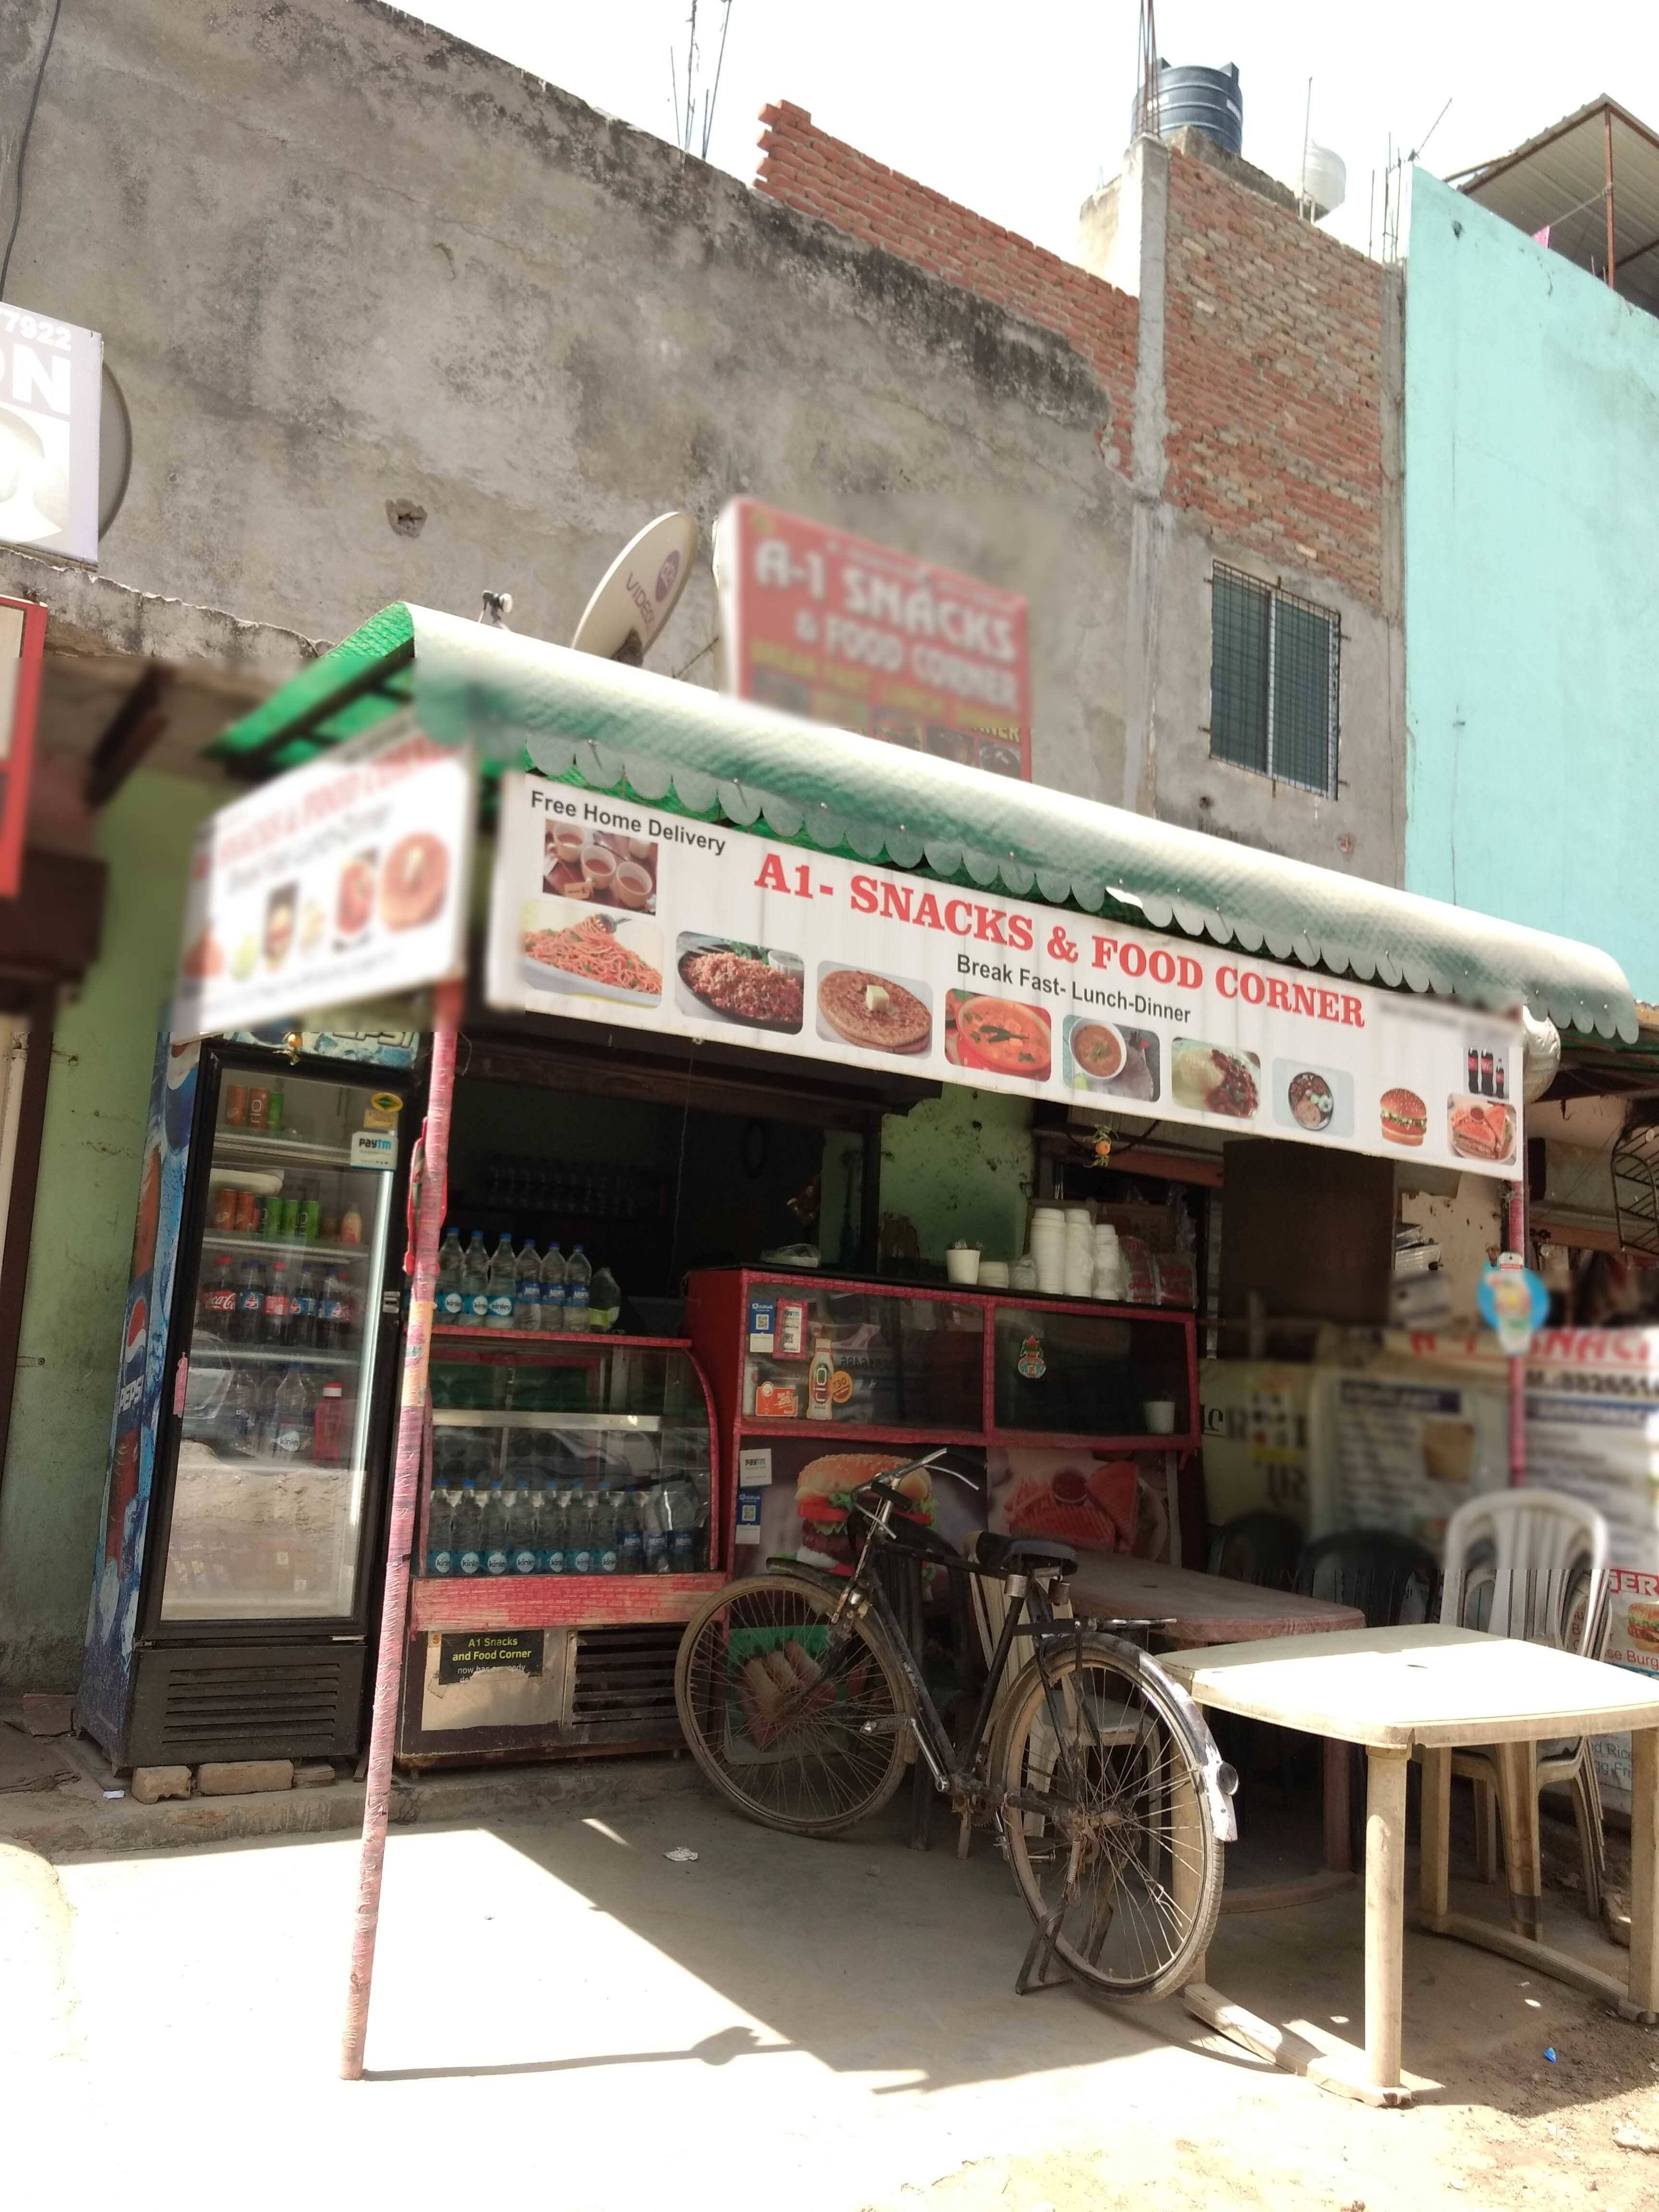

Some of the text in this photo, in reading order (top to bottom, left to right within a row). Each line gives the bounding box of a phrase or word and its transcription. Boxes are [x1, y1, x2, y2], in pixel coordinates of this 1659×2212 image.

[0, 309, 72, 351] 7922
[0, 343, 71, 415] N
[841, 565, 1017, 663] SNACKS
[530, 790, 726, 856] Free Home Delivery
[754, 853, 834, 900] A1-
[850, 875, 1034, 951] SNACKS
[1046, 926, 1079, 963] &
[1091, 934, 1203, 990] FOOD
[1215, 965, 1366, 1028] CORNER
[957, 953, 1191, 1023] Break Fast- Lunch-Dinner
[359, 1137, 392, 1150] paytm
[119, 1374, 144, 1414] PEPSI
[452, 1650, 532, 1661] and Food Corner
[468, 1636, 518, 1647] A1 Snacks
[1627, 1649, 1659, 1671] Burg
[457, 1666, 474, 1674] now
